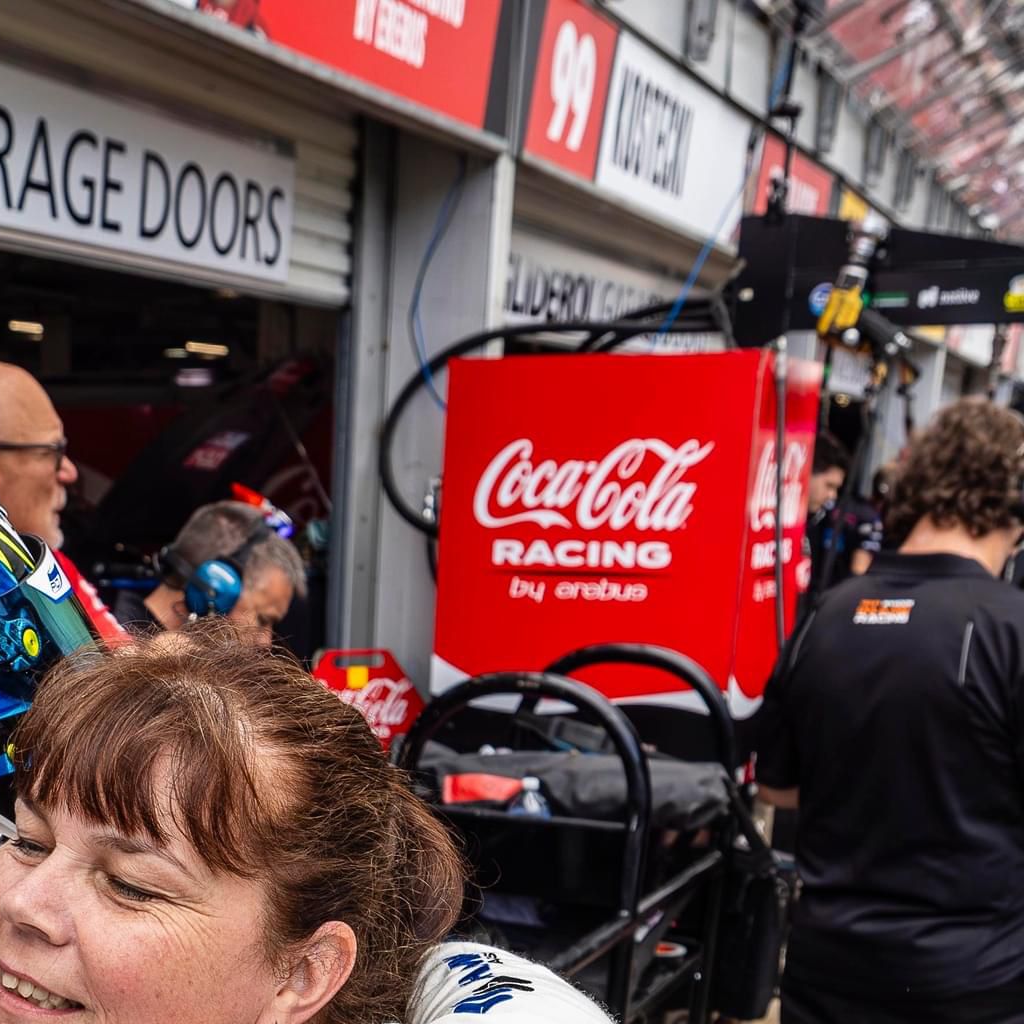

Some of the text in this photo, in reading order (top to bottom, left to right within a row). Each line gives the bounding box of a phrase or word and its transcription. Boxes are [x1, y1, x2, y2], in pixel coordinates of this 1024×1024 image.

[546, 20, 597, 152] 99
[139, 149, 285, 267] DOORS
[472, 438, 717, 533] Coca-Cola
[491, 538, 674, 570] RACING
[508, 575, 547, 603] by
